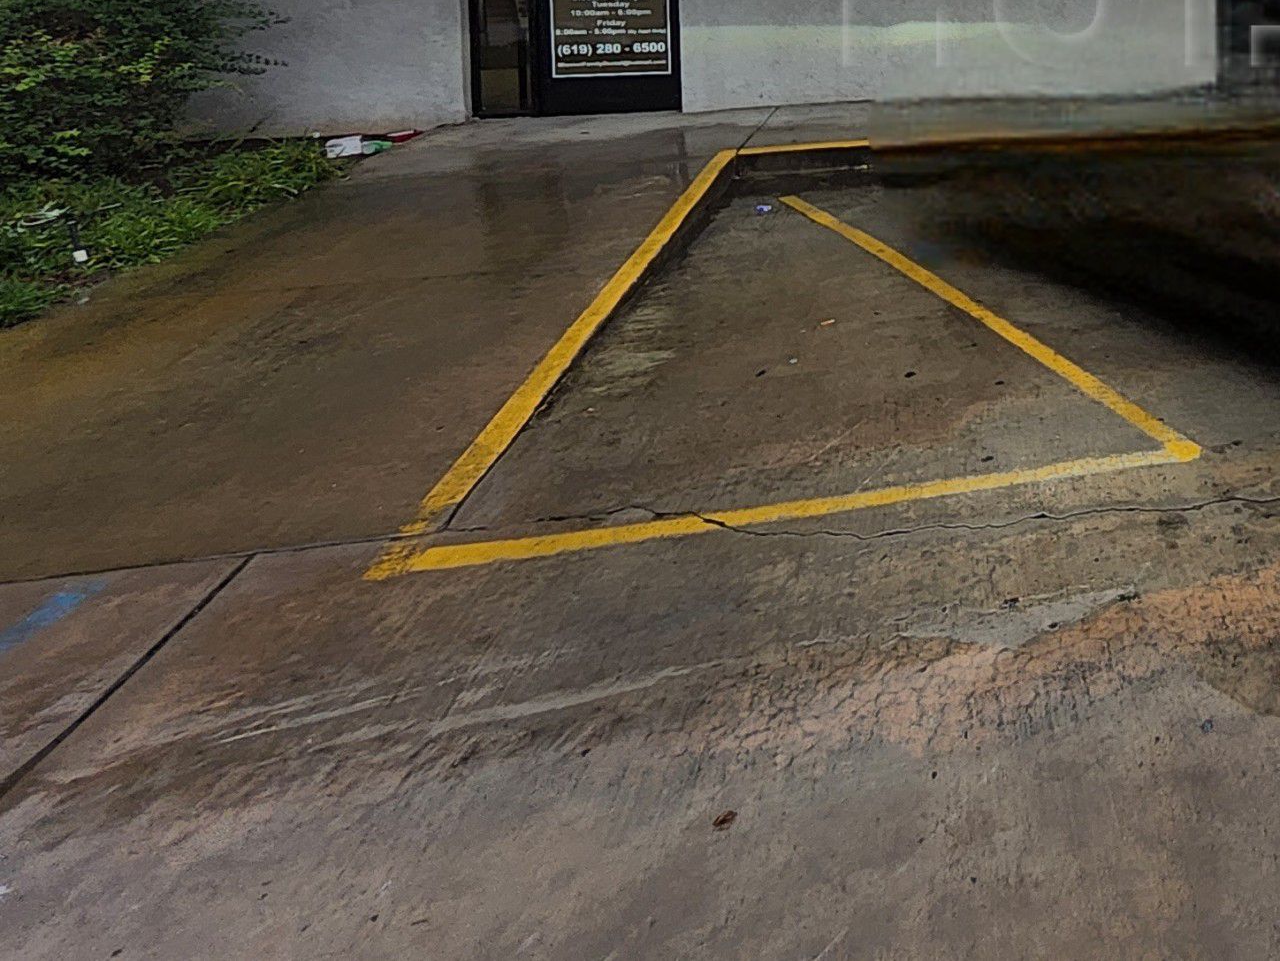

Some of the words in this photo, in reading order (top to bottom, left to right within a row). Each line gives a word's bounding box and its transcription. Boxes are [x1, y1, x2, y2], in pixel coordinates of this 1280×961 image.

[592, 1, 631, 9] Tuesday
[596, 19, 627, 27] Friday
[557, 43, 593, 58] (619)
[596, 43, 622, 54] 280
[632, 42, 666, 53] 6500
